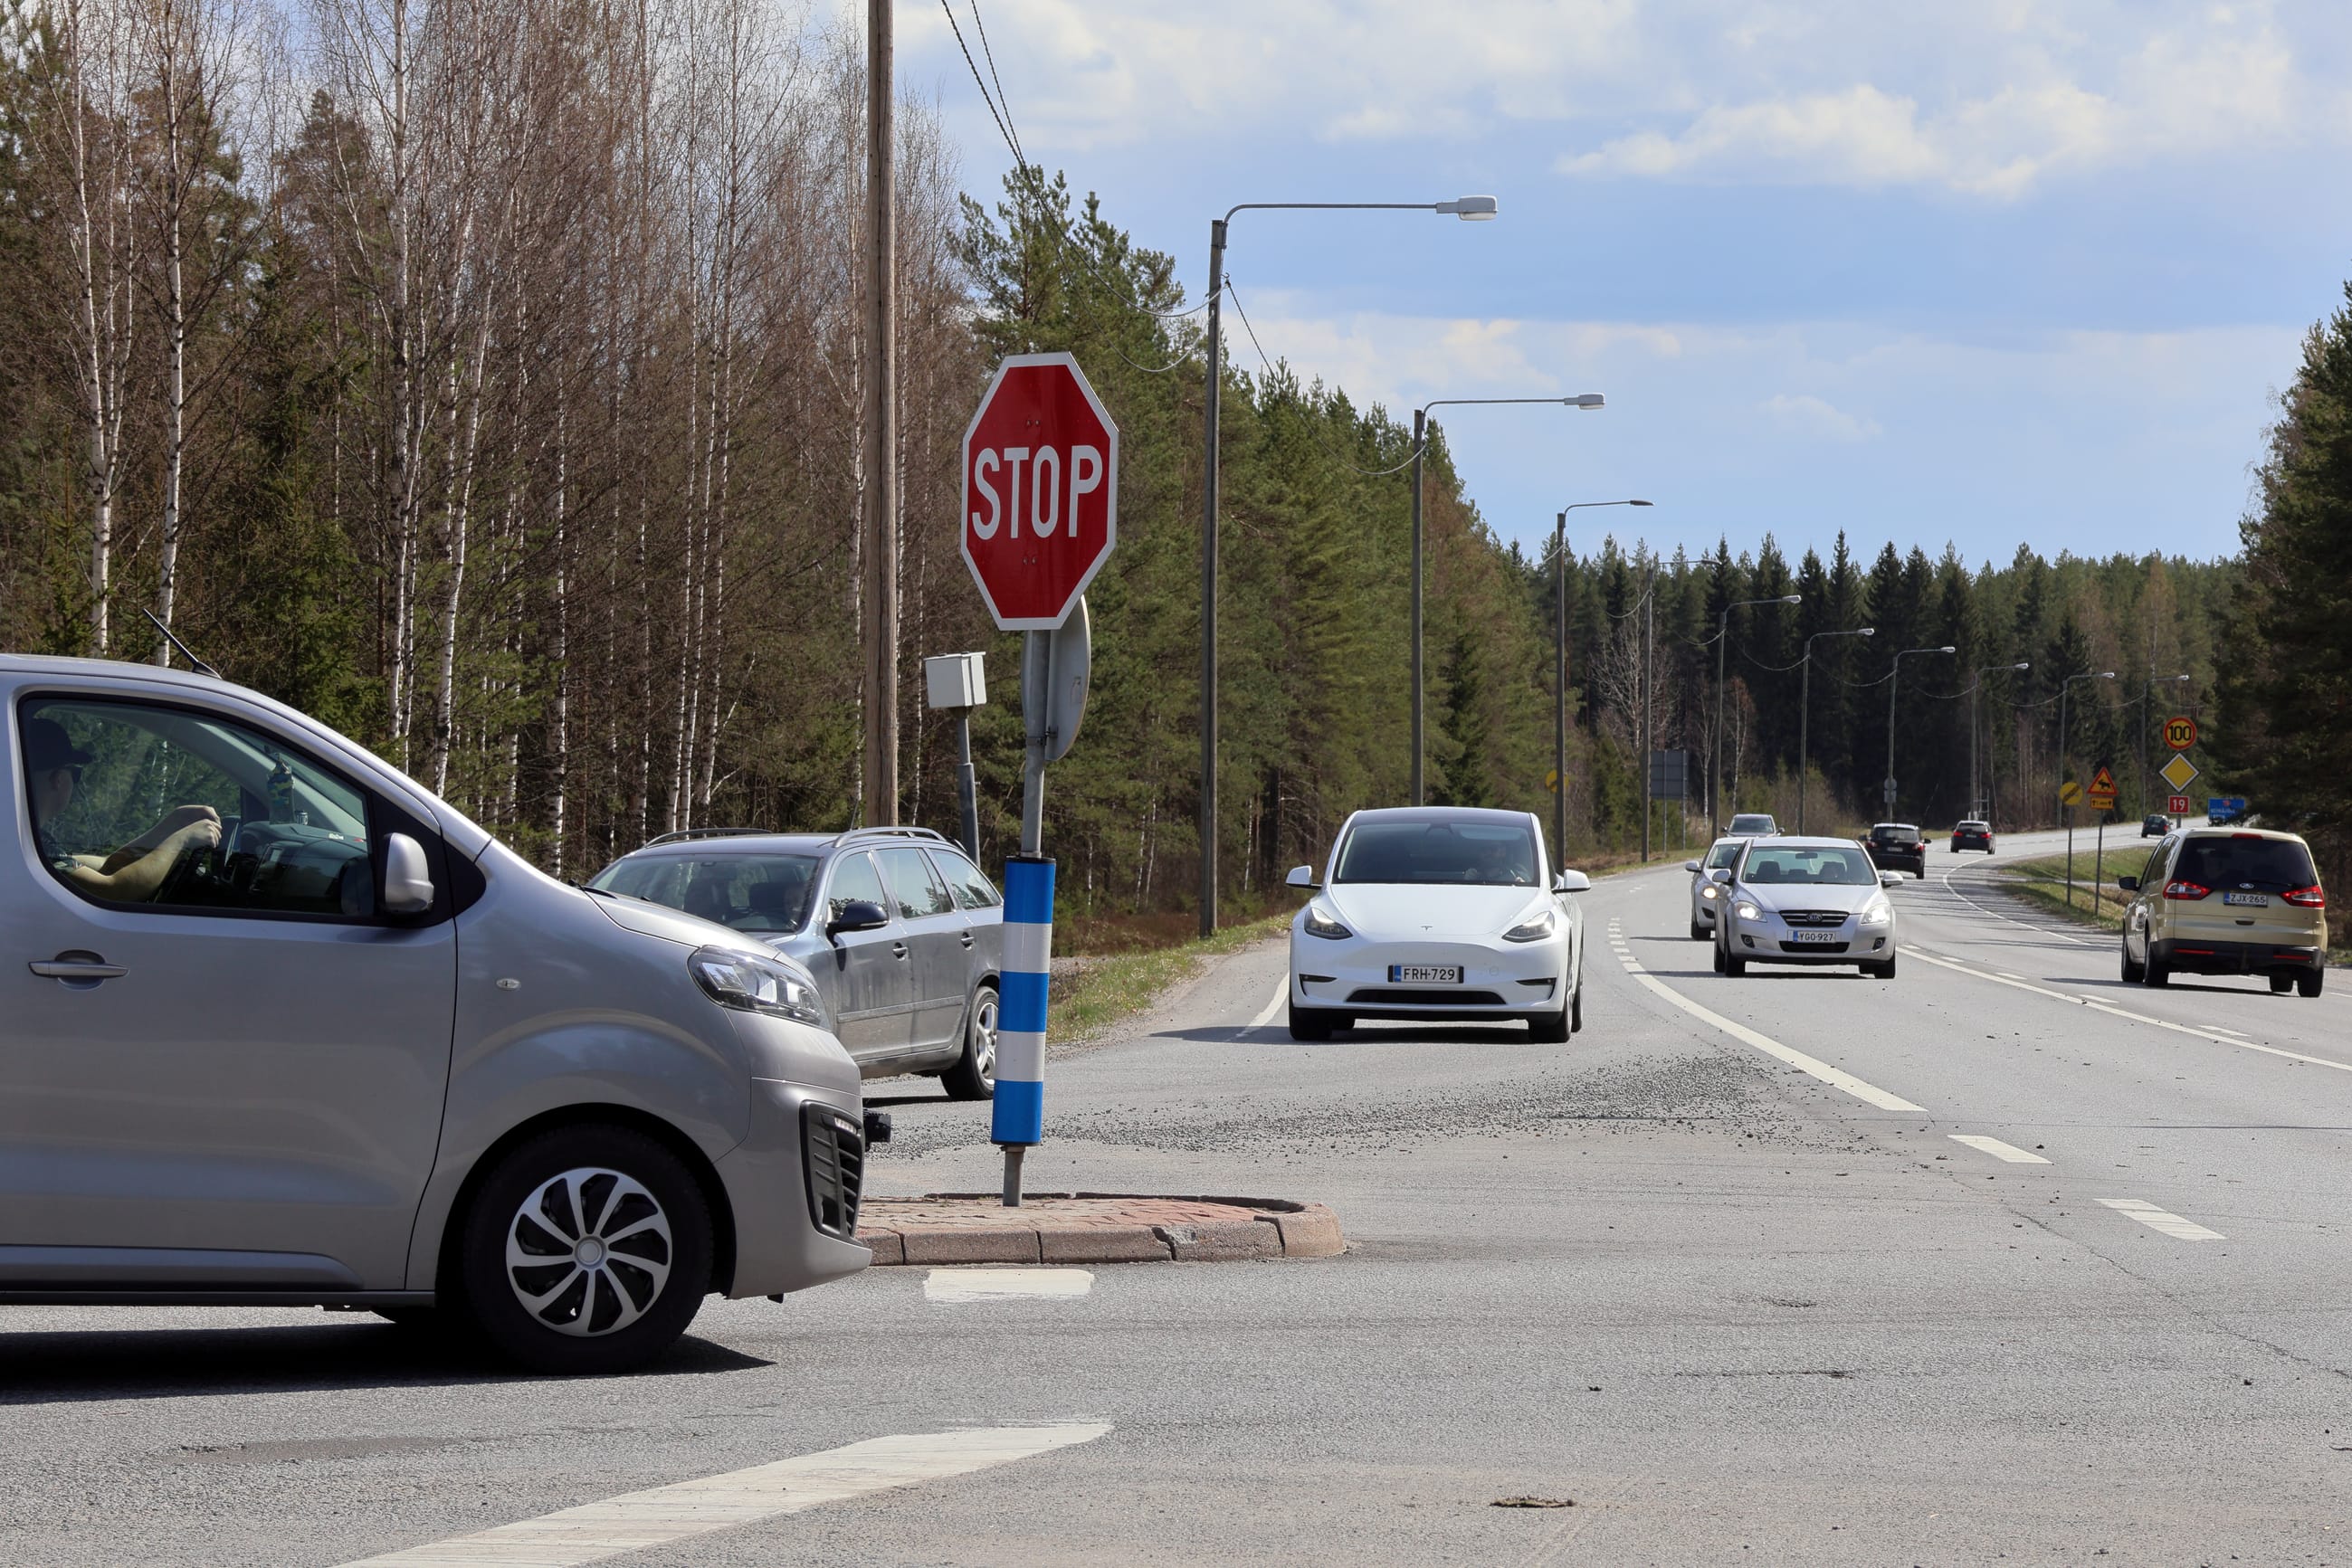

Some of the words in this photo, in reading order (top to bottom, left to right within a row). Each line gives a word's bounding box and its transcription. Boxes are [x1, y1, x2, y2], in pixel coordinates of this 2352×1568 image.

[972, 445, 1103, 540] STOP
[2169, 726, 2192, 741] 100
[2173, 799, 2185, 811] 19
[2231, 894, 2266, 904] ZJX-265
[1799, 933, 1833, 941] YGO-927
[1404, 968, 1455, 980] FRH-729
